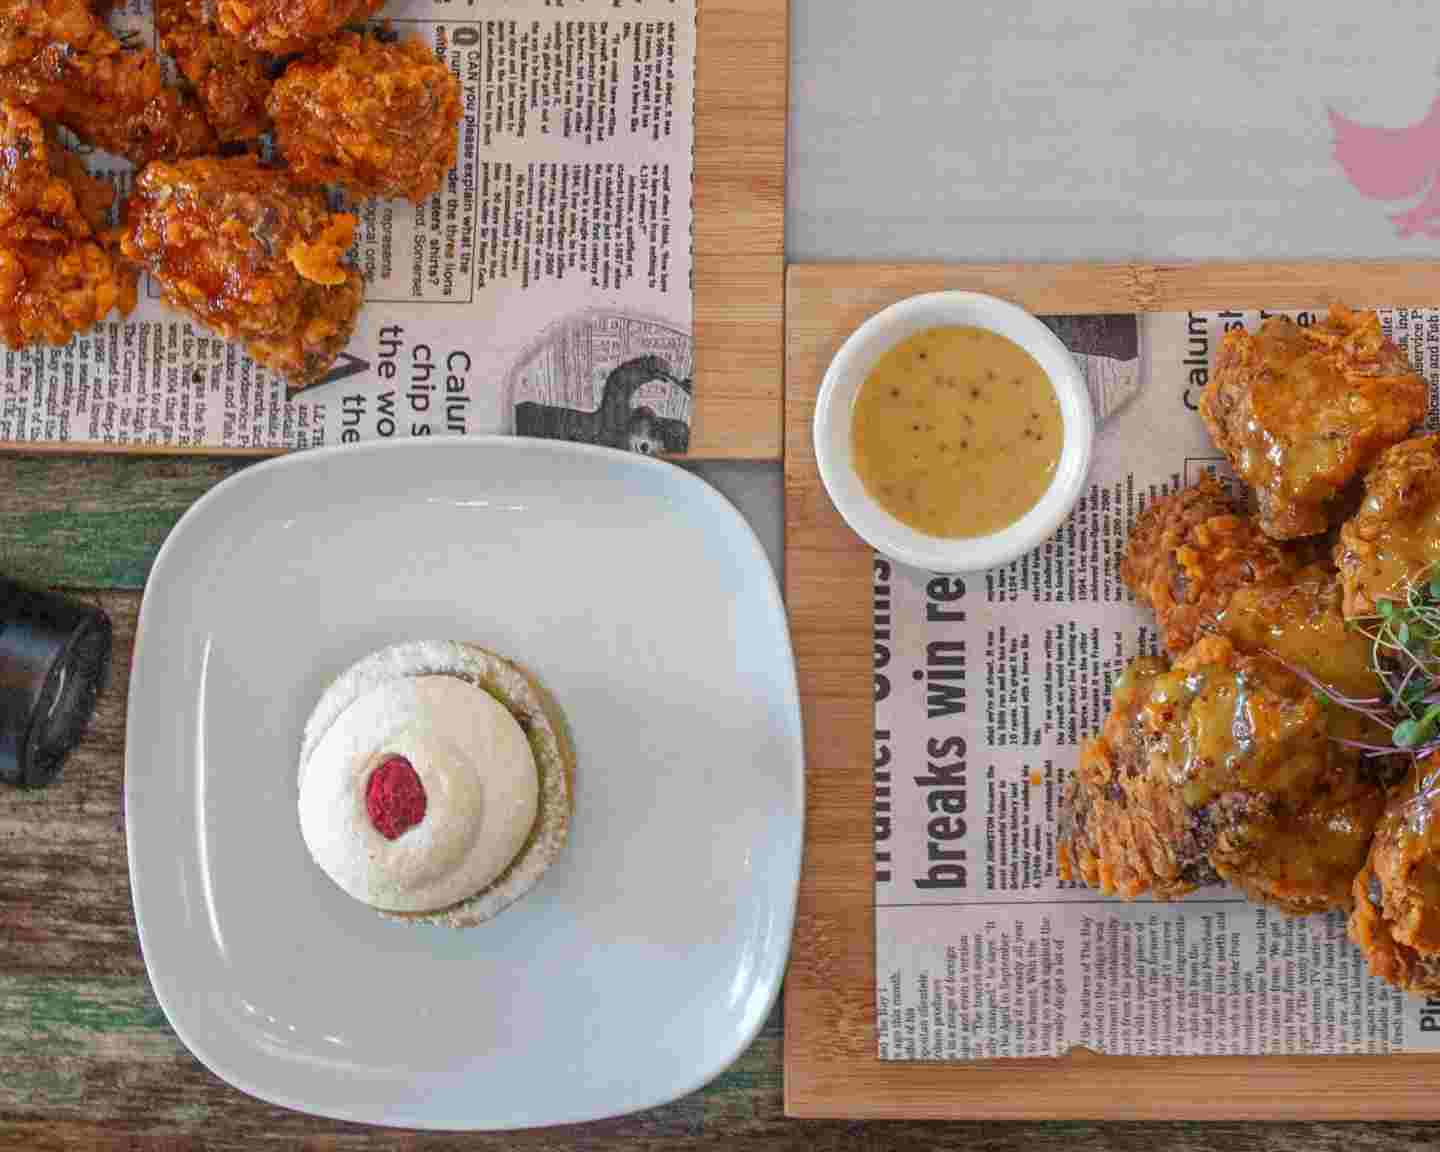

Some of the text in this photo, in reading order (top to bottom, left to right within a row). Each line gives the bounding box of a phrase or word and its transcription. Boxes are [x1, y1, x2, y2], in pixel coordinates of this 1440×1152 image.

[467, 50, 481, 82] CAN
[463, 86, 477, 110] you
[461, 114, 479, 160] please
[460, 162, 477, 212] explain
[379, 208, 395, 280] represents
[443, 167, 460, 296] nder the three lions
[461, 216, 475, 248] what
[429, 238, 443, 286] shirts?
[460, 252, 474, 274] the
[378, 326, 405, 379] the
[406, 344, 435, 411] chip
[342, 394, 367, 444] the
[912, 640, 967, 719] win
[912, 736, 967, 889] breaks
